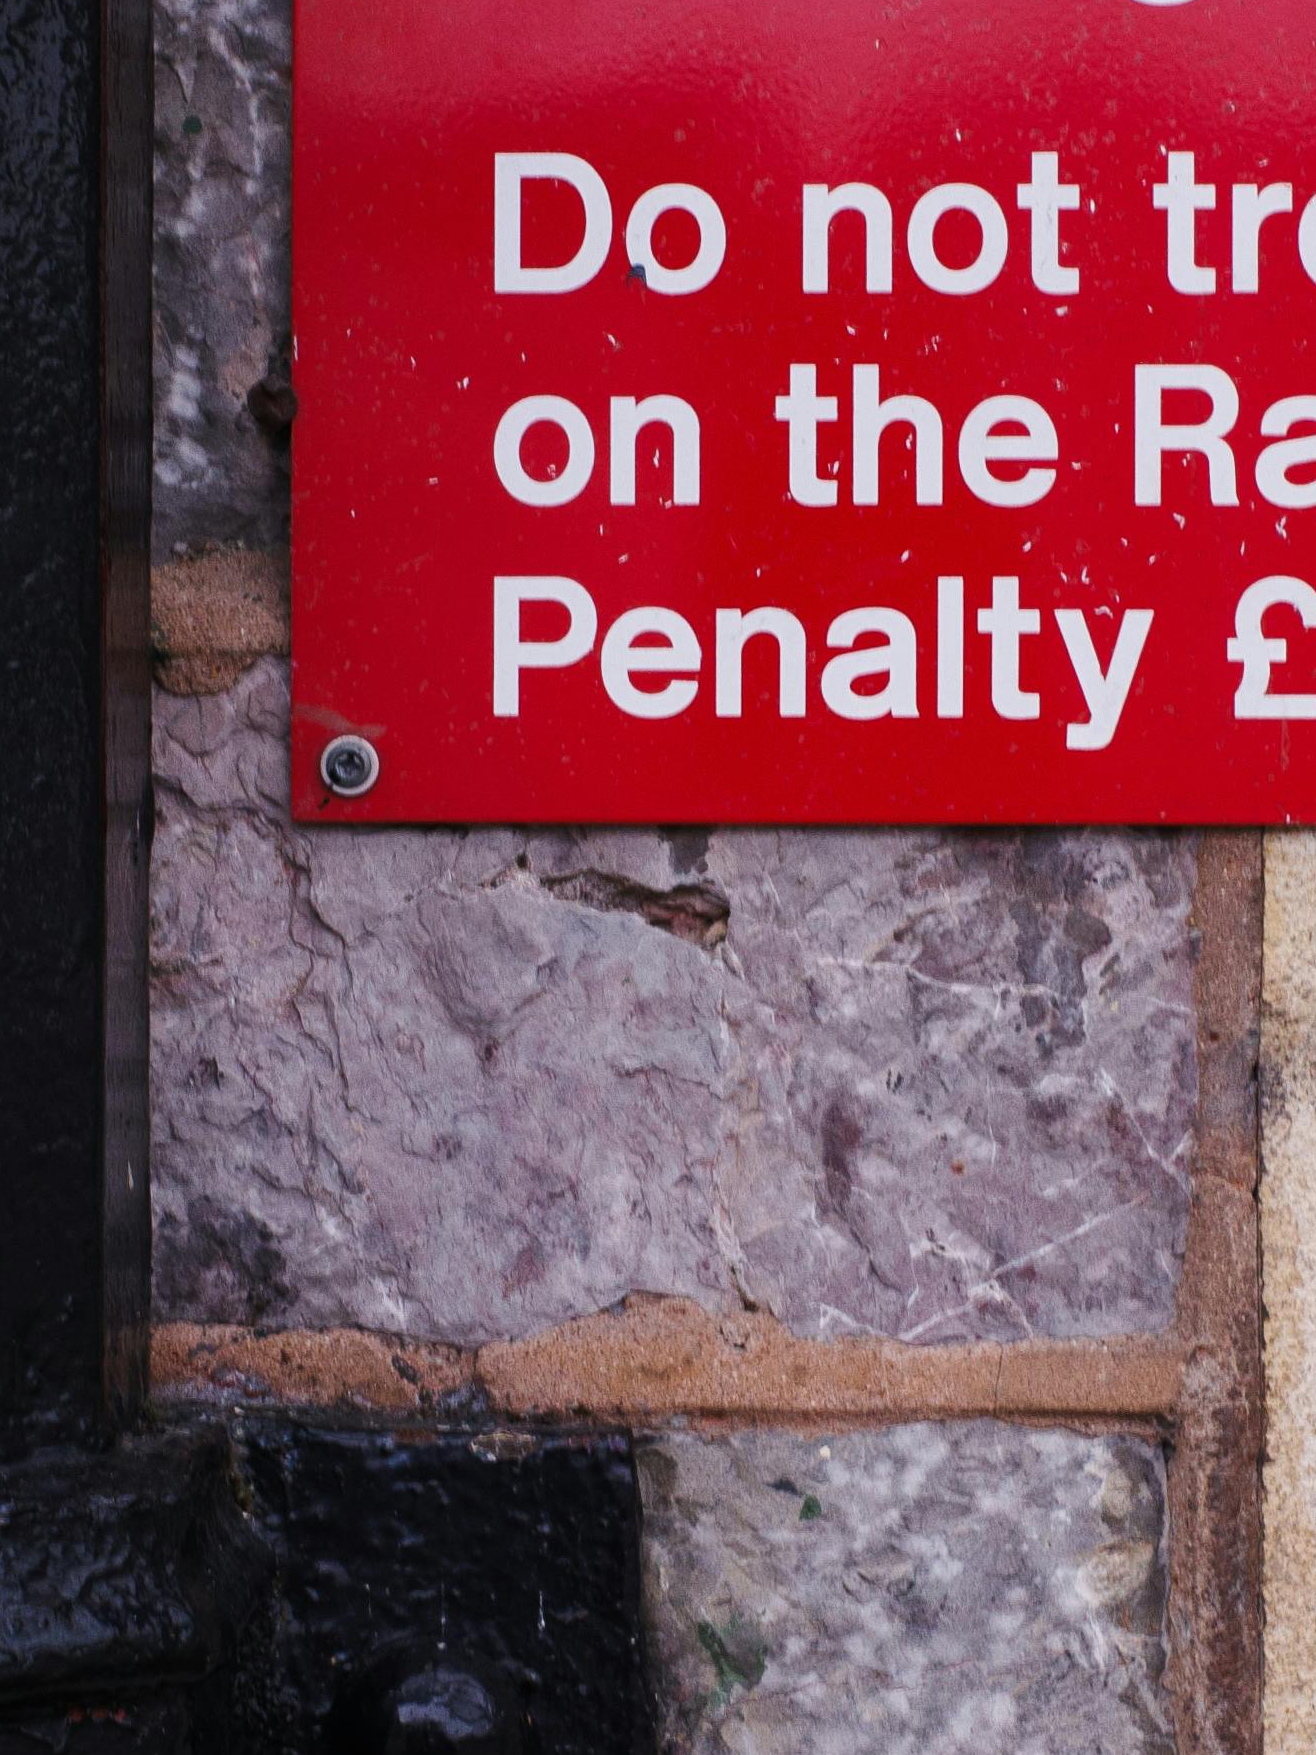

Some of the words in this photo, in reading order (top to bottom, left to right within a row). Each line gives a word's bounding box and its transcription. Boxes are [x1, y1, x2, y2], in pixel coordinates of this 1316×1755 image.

[493, 151, 728, 296] Do
[801, 150, 1081, 296] not
[492, 393, 701, 507] on
[774, 362, 1060, 508] the
[492, 575, 1155, 751] Penalty
